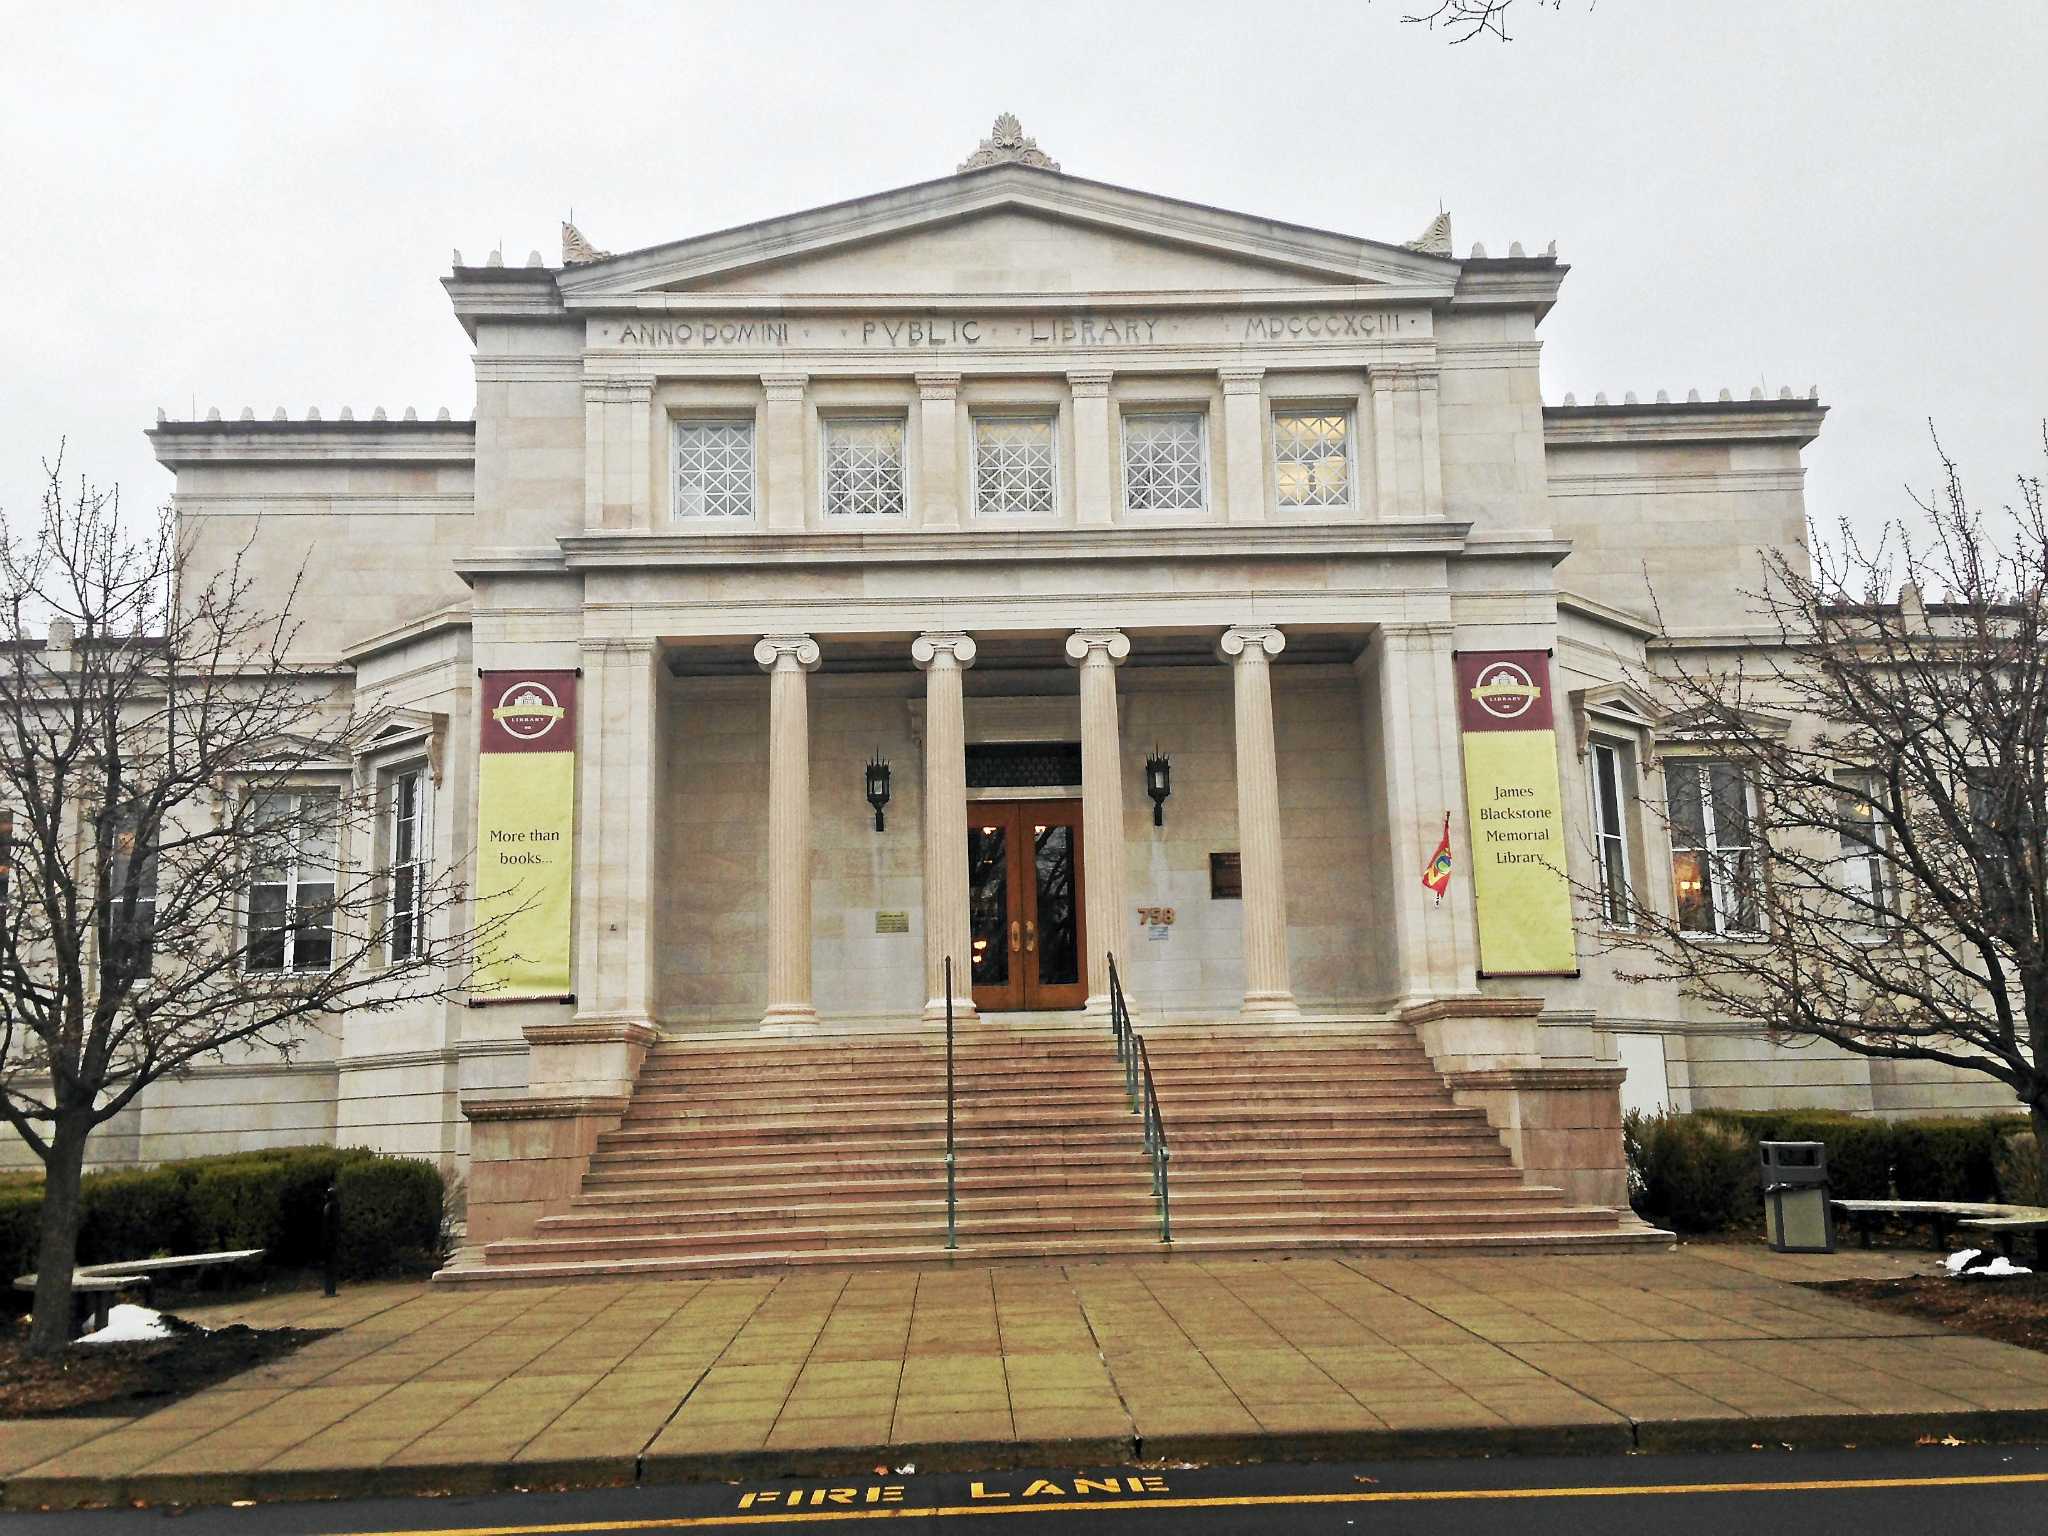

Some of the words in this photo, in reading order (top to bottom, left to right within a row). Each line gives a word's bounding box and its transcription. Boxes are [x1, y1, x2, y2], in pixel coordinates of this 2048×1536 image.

[620, 323, 692, 345] ANNO
[703, 322, 788, 345] DOMINI
[862, 320, 981, 346] PVBLIC
[1029, 318, 1158, 345] LIBRARY
[1244, 312, 1400, 339] MDCCCXCIII
[1493, 786, 1534, 801] James
[1479, 807, 1552, 820] Blackstone
[489, 829, 526, 842] More
[530, 829, 560, 841] than
[1486, 828, 1549, 842] Memorial
[1496, 851, 1544, 864] Library
[738, 1485, 905, 1509] FIRE
[969, 1476, 1170, 1499] LANE
